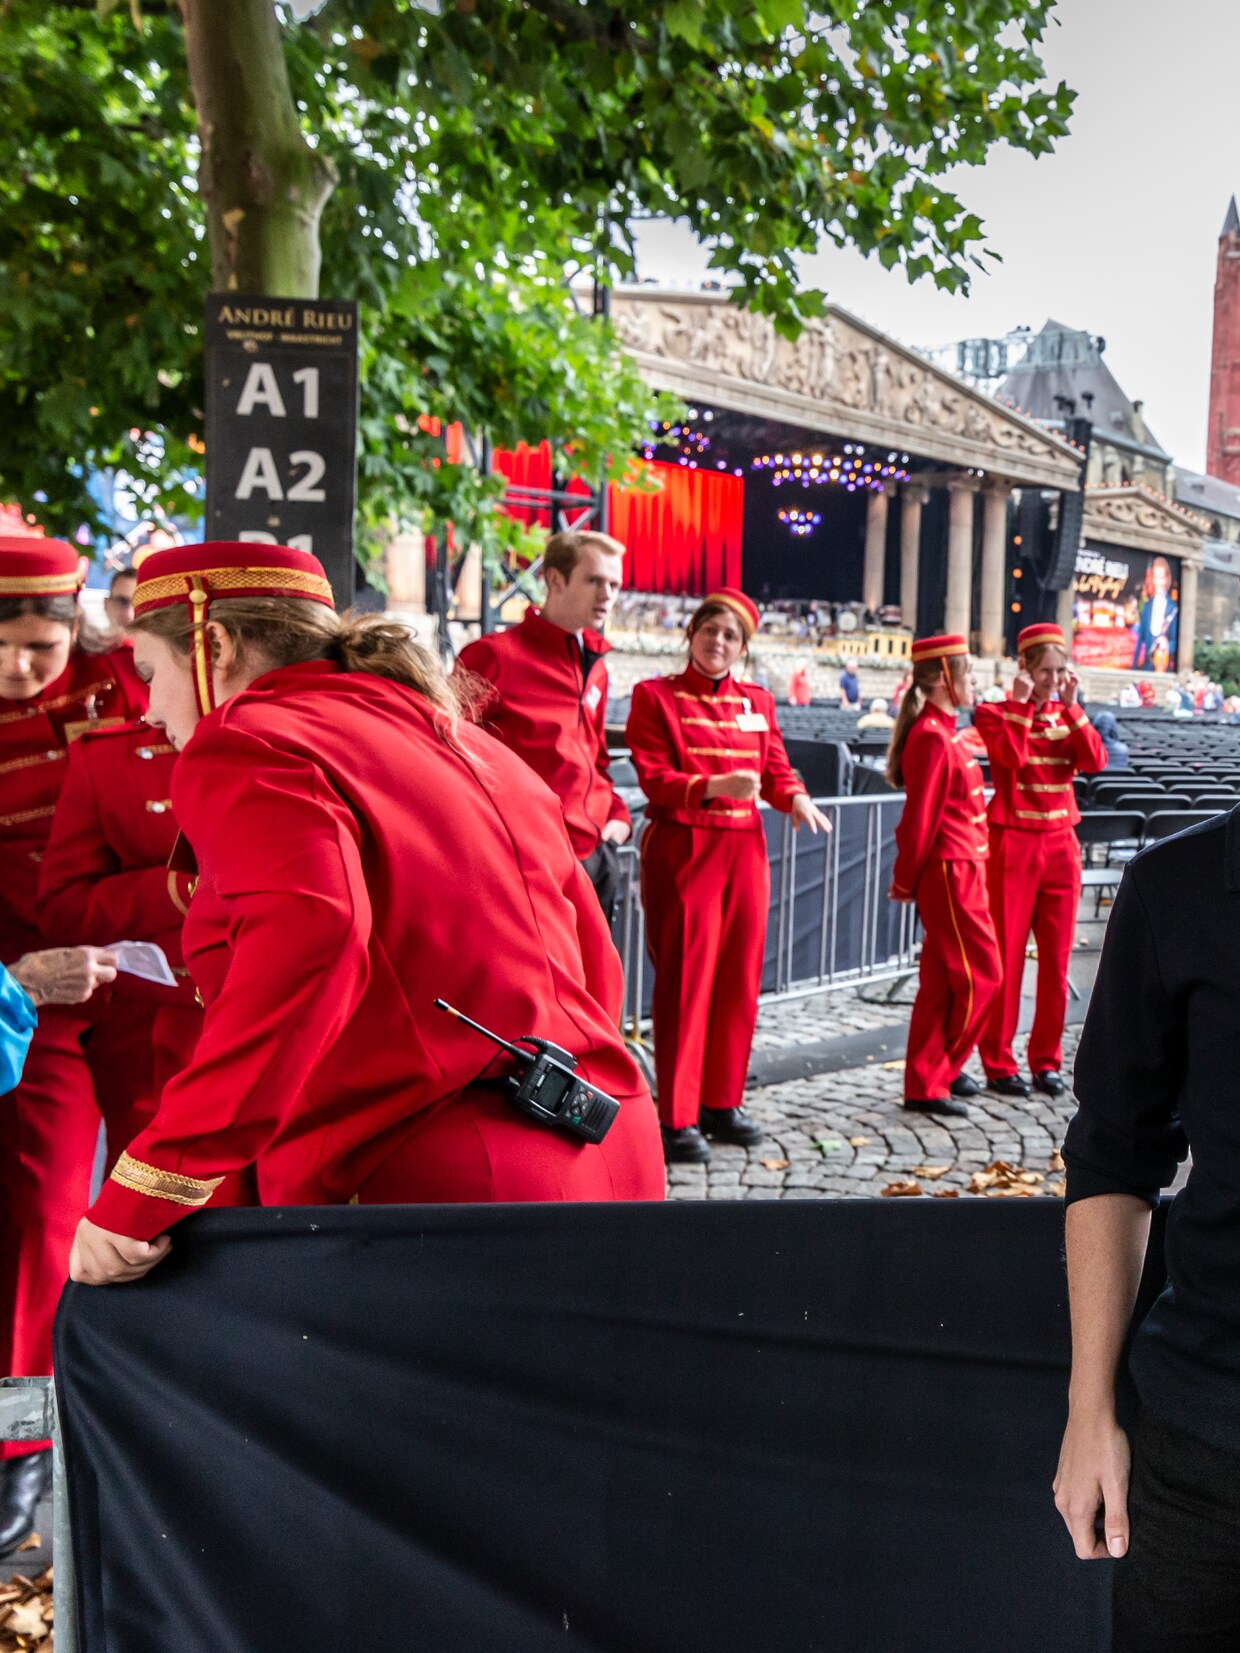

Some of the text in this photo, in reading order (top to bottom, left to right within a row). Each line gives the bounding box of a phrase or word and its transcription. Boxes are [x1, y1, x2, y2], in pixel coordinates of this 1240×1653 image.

[219, 306, 352, 331] ANDRÉ RIEU
[236, 363, 319, 419] A1
[235, 447, 326, 502] A2
